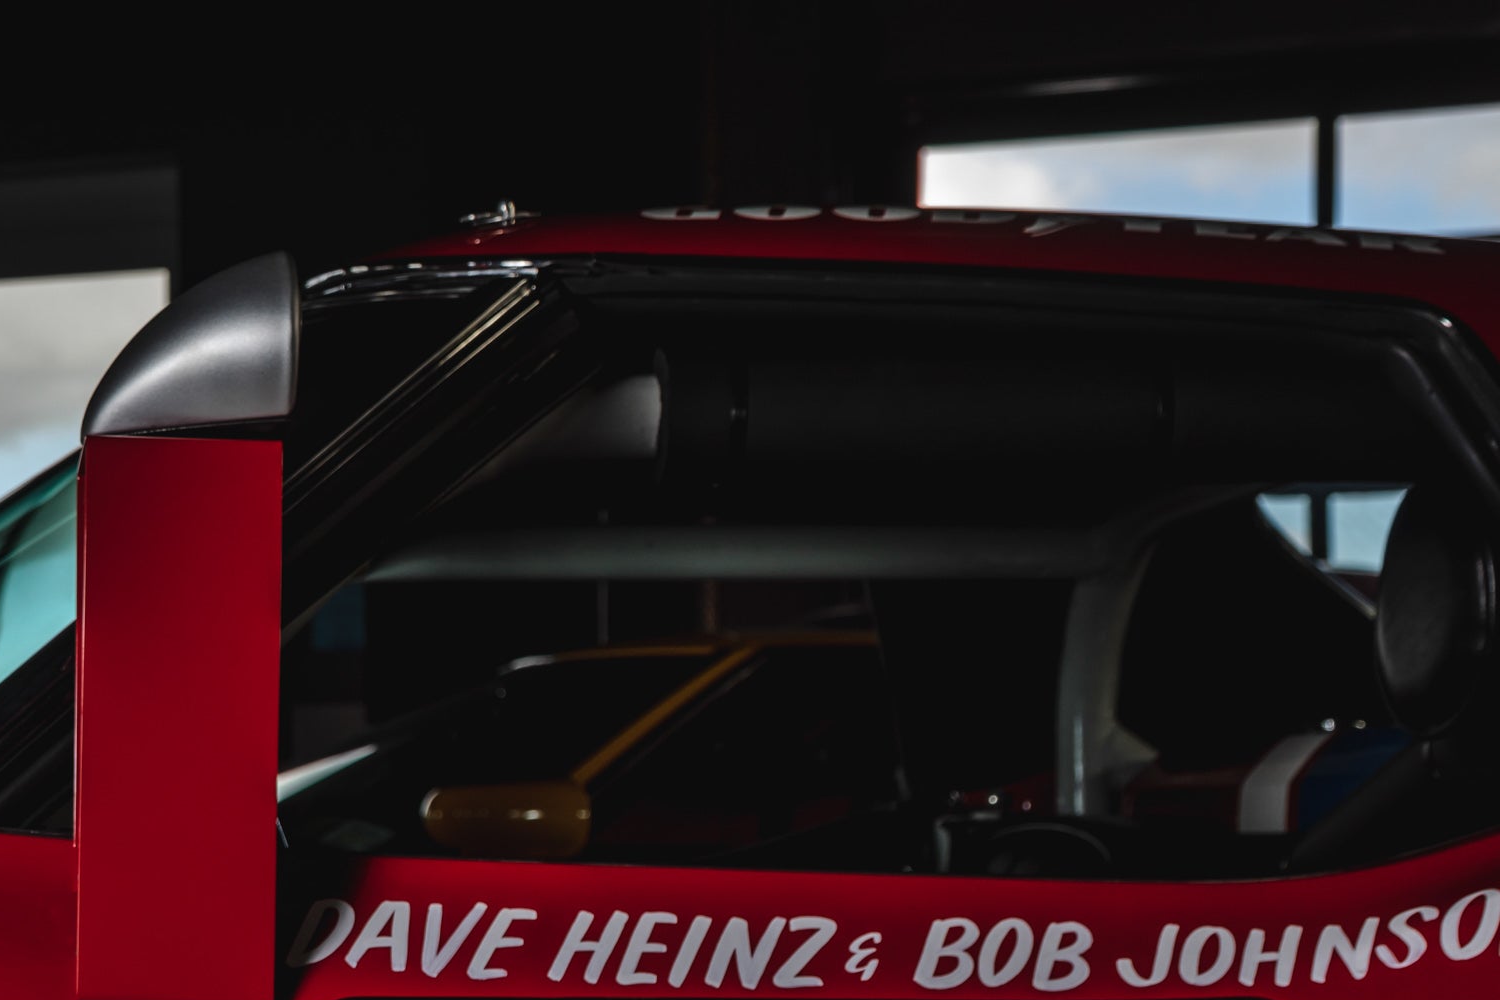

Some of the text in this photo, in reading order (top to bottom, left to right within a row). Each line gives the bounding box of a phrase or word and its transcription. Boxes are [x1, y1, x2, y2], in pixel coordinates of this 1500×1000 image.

[286, 888, 1500, 992] DAVE HEINZ & BOB JOHNSO
